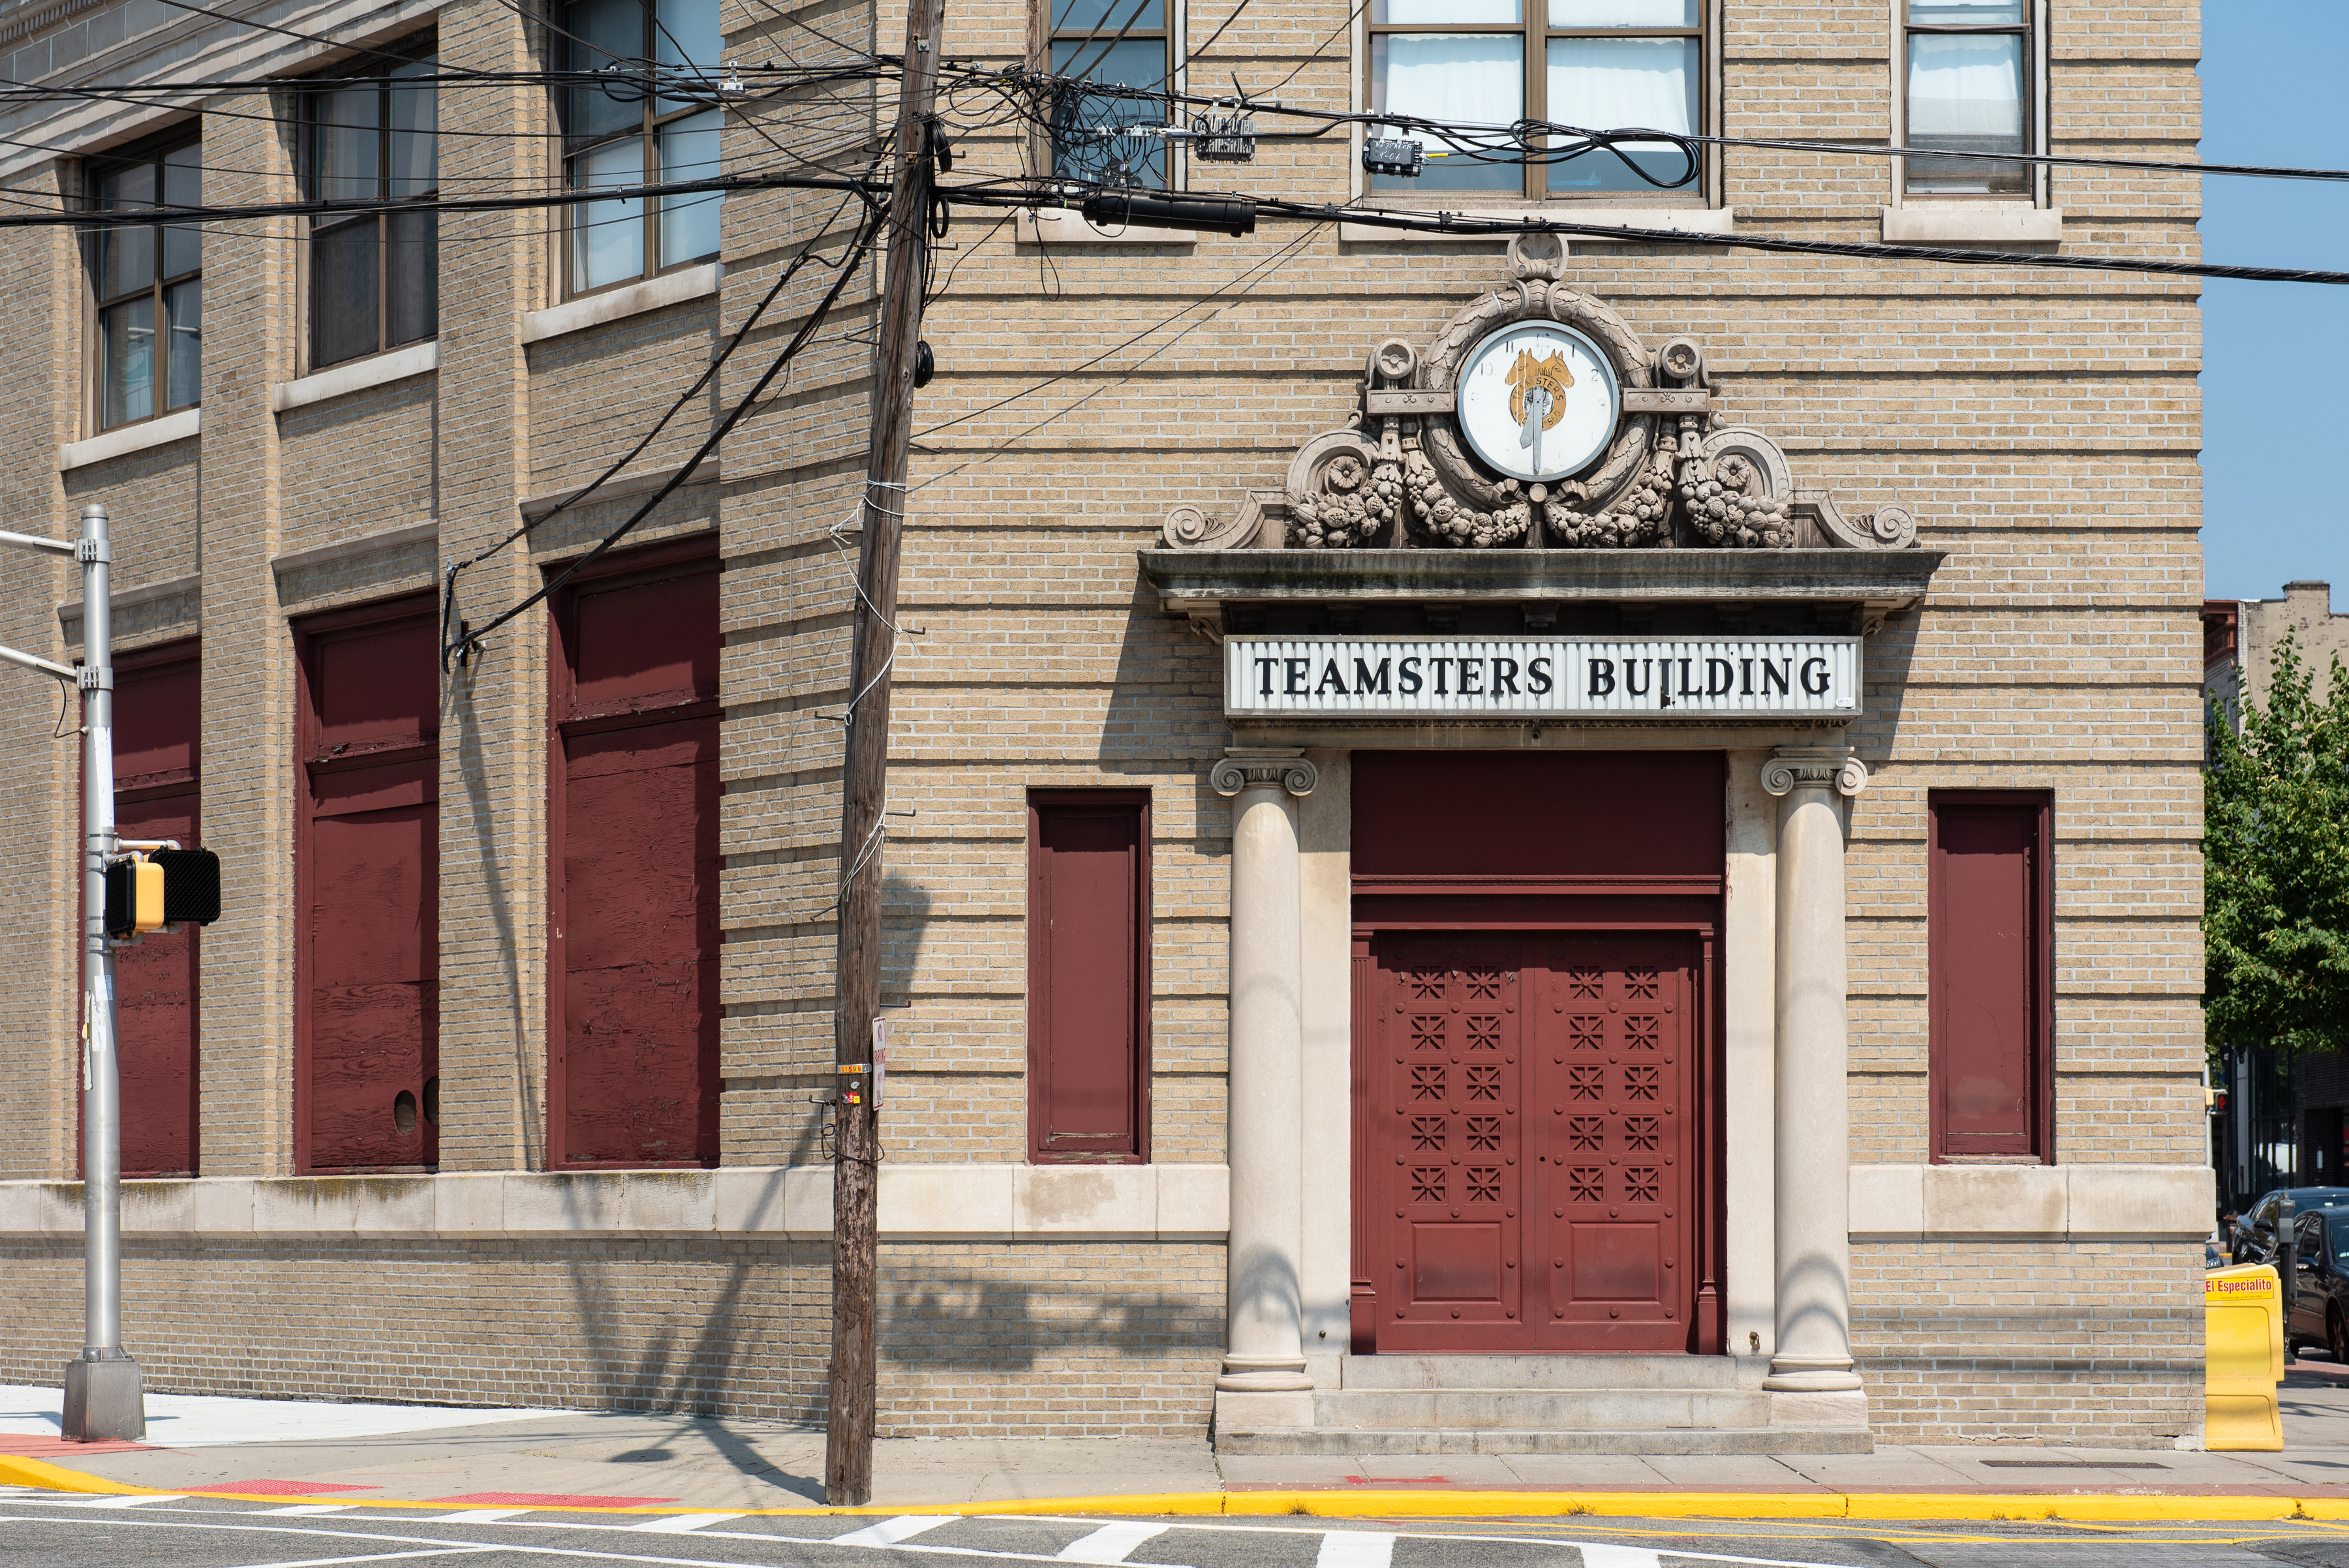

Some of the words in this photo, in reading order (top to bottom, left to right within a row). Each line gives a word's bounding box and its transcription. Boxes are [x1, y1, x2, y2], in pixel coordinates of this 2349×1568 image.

[1591, 369, 1599, 382] 2
[1512, 377, 1564, 401] TEAMSTERS
[1547, 410, 1561, 425] 560
[1255, 656, 1552, 696] TEAMSTERS
[1588, 656, 1831, 696] BUILDING
[2205, 1280, 2215, 1293] El
[2217, 1278, 2272, 1295] Especialito
